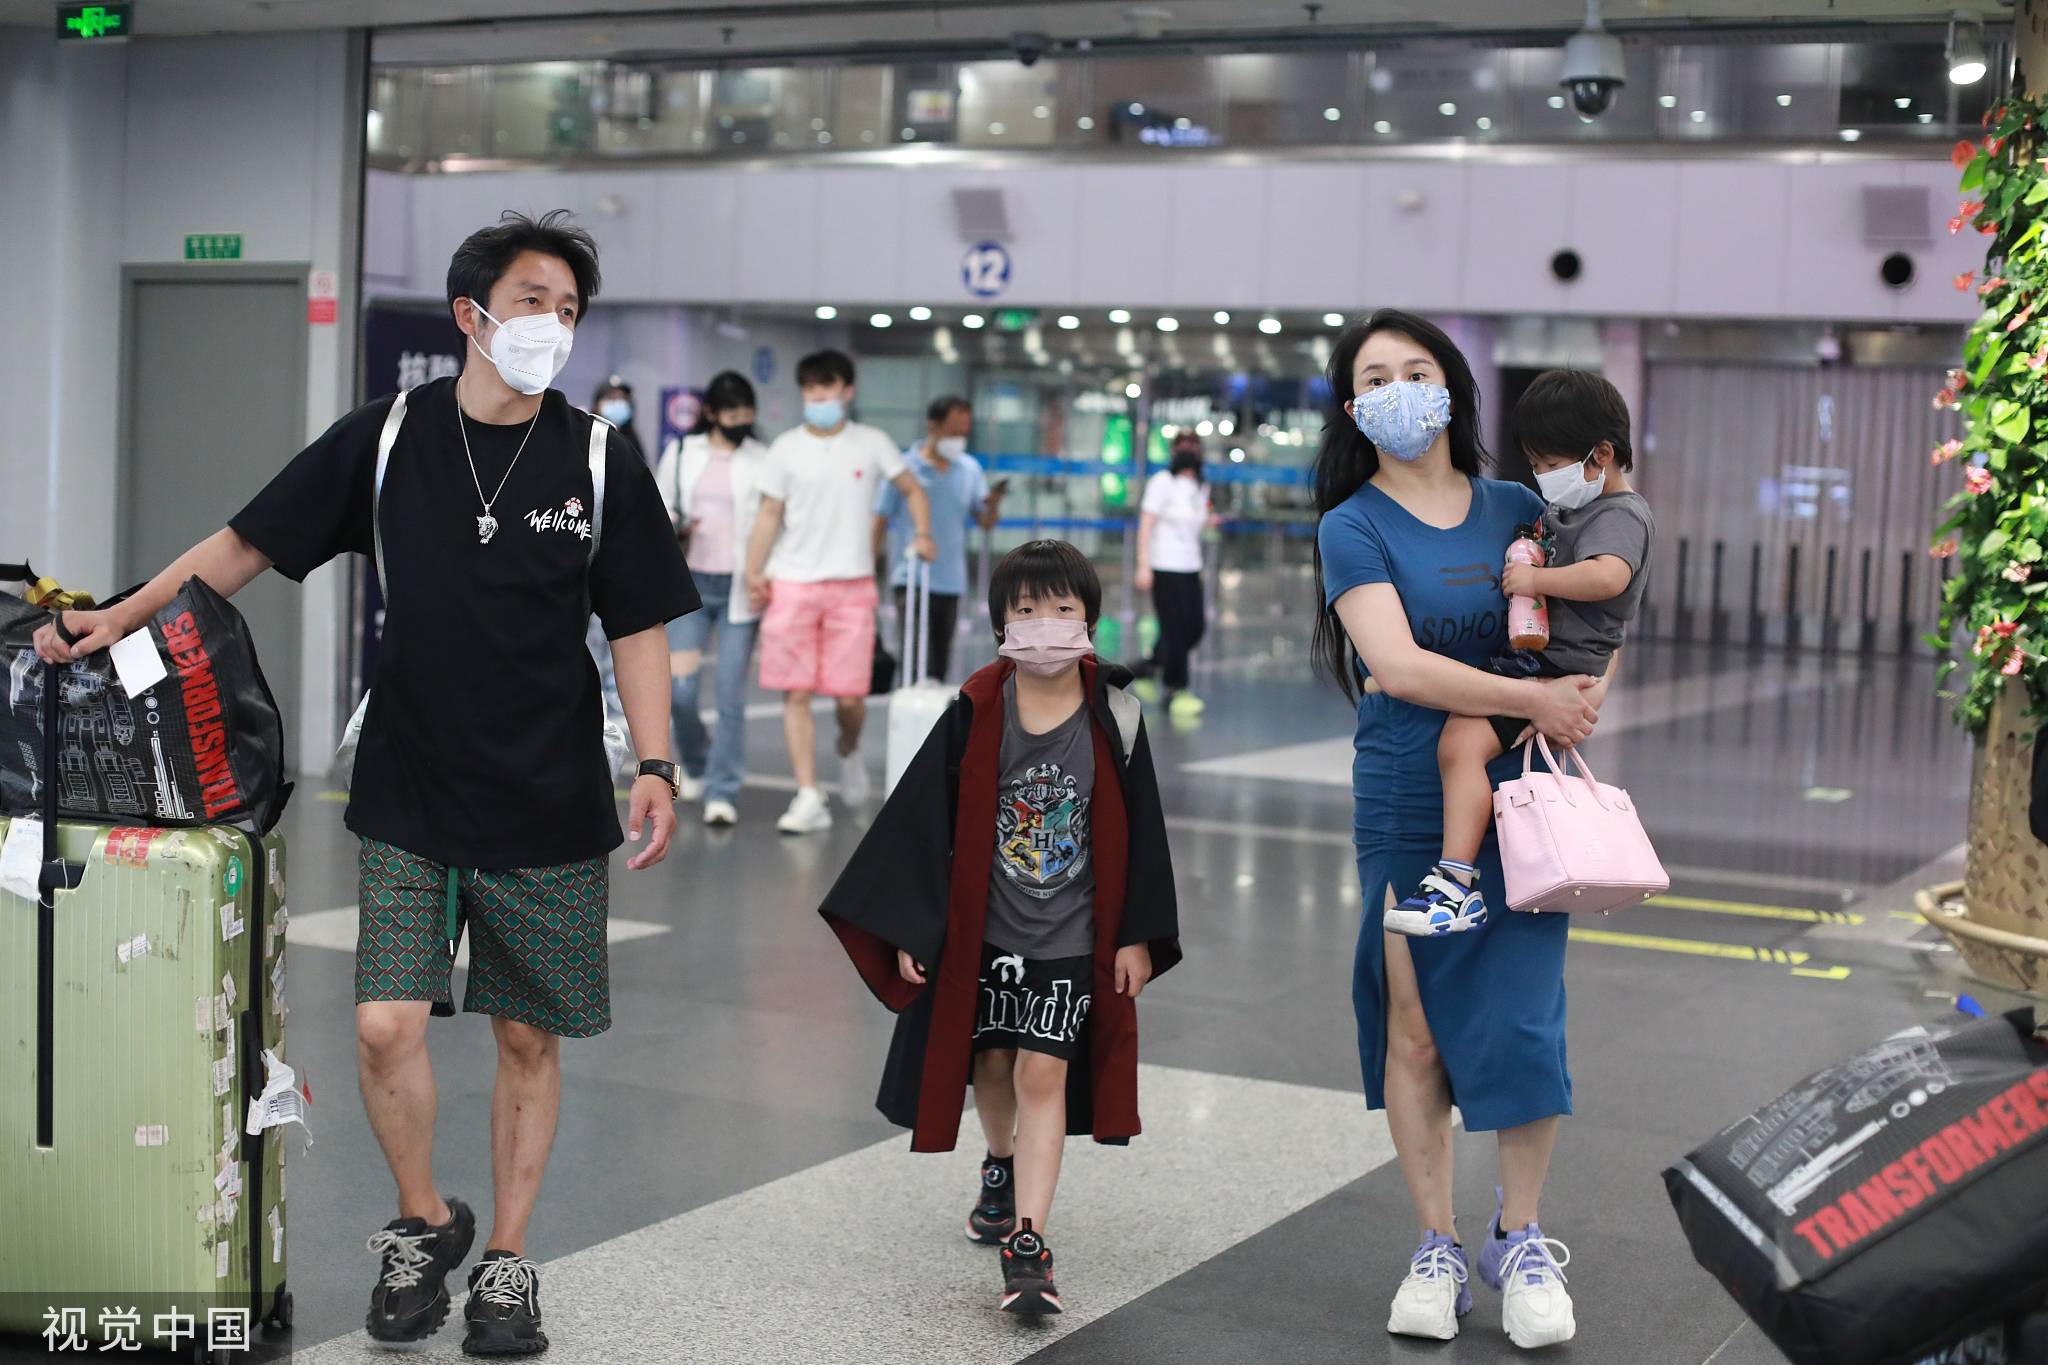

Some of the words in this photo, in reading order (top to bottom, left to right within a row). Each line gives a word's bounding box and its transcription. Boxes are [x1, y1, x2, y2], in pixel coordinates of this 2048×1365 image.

[966, 250, 1003, 289] 12
[160, 609, 242, 819] TRANSFORMERS
[1034, 831, 1052, 850] H
